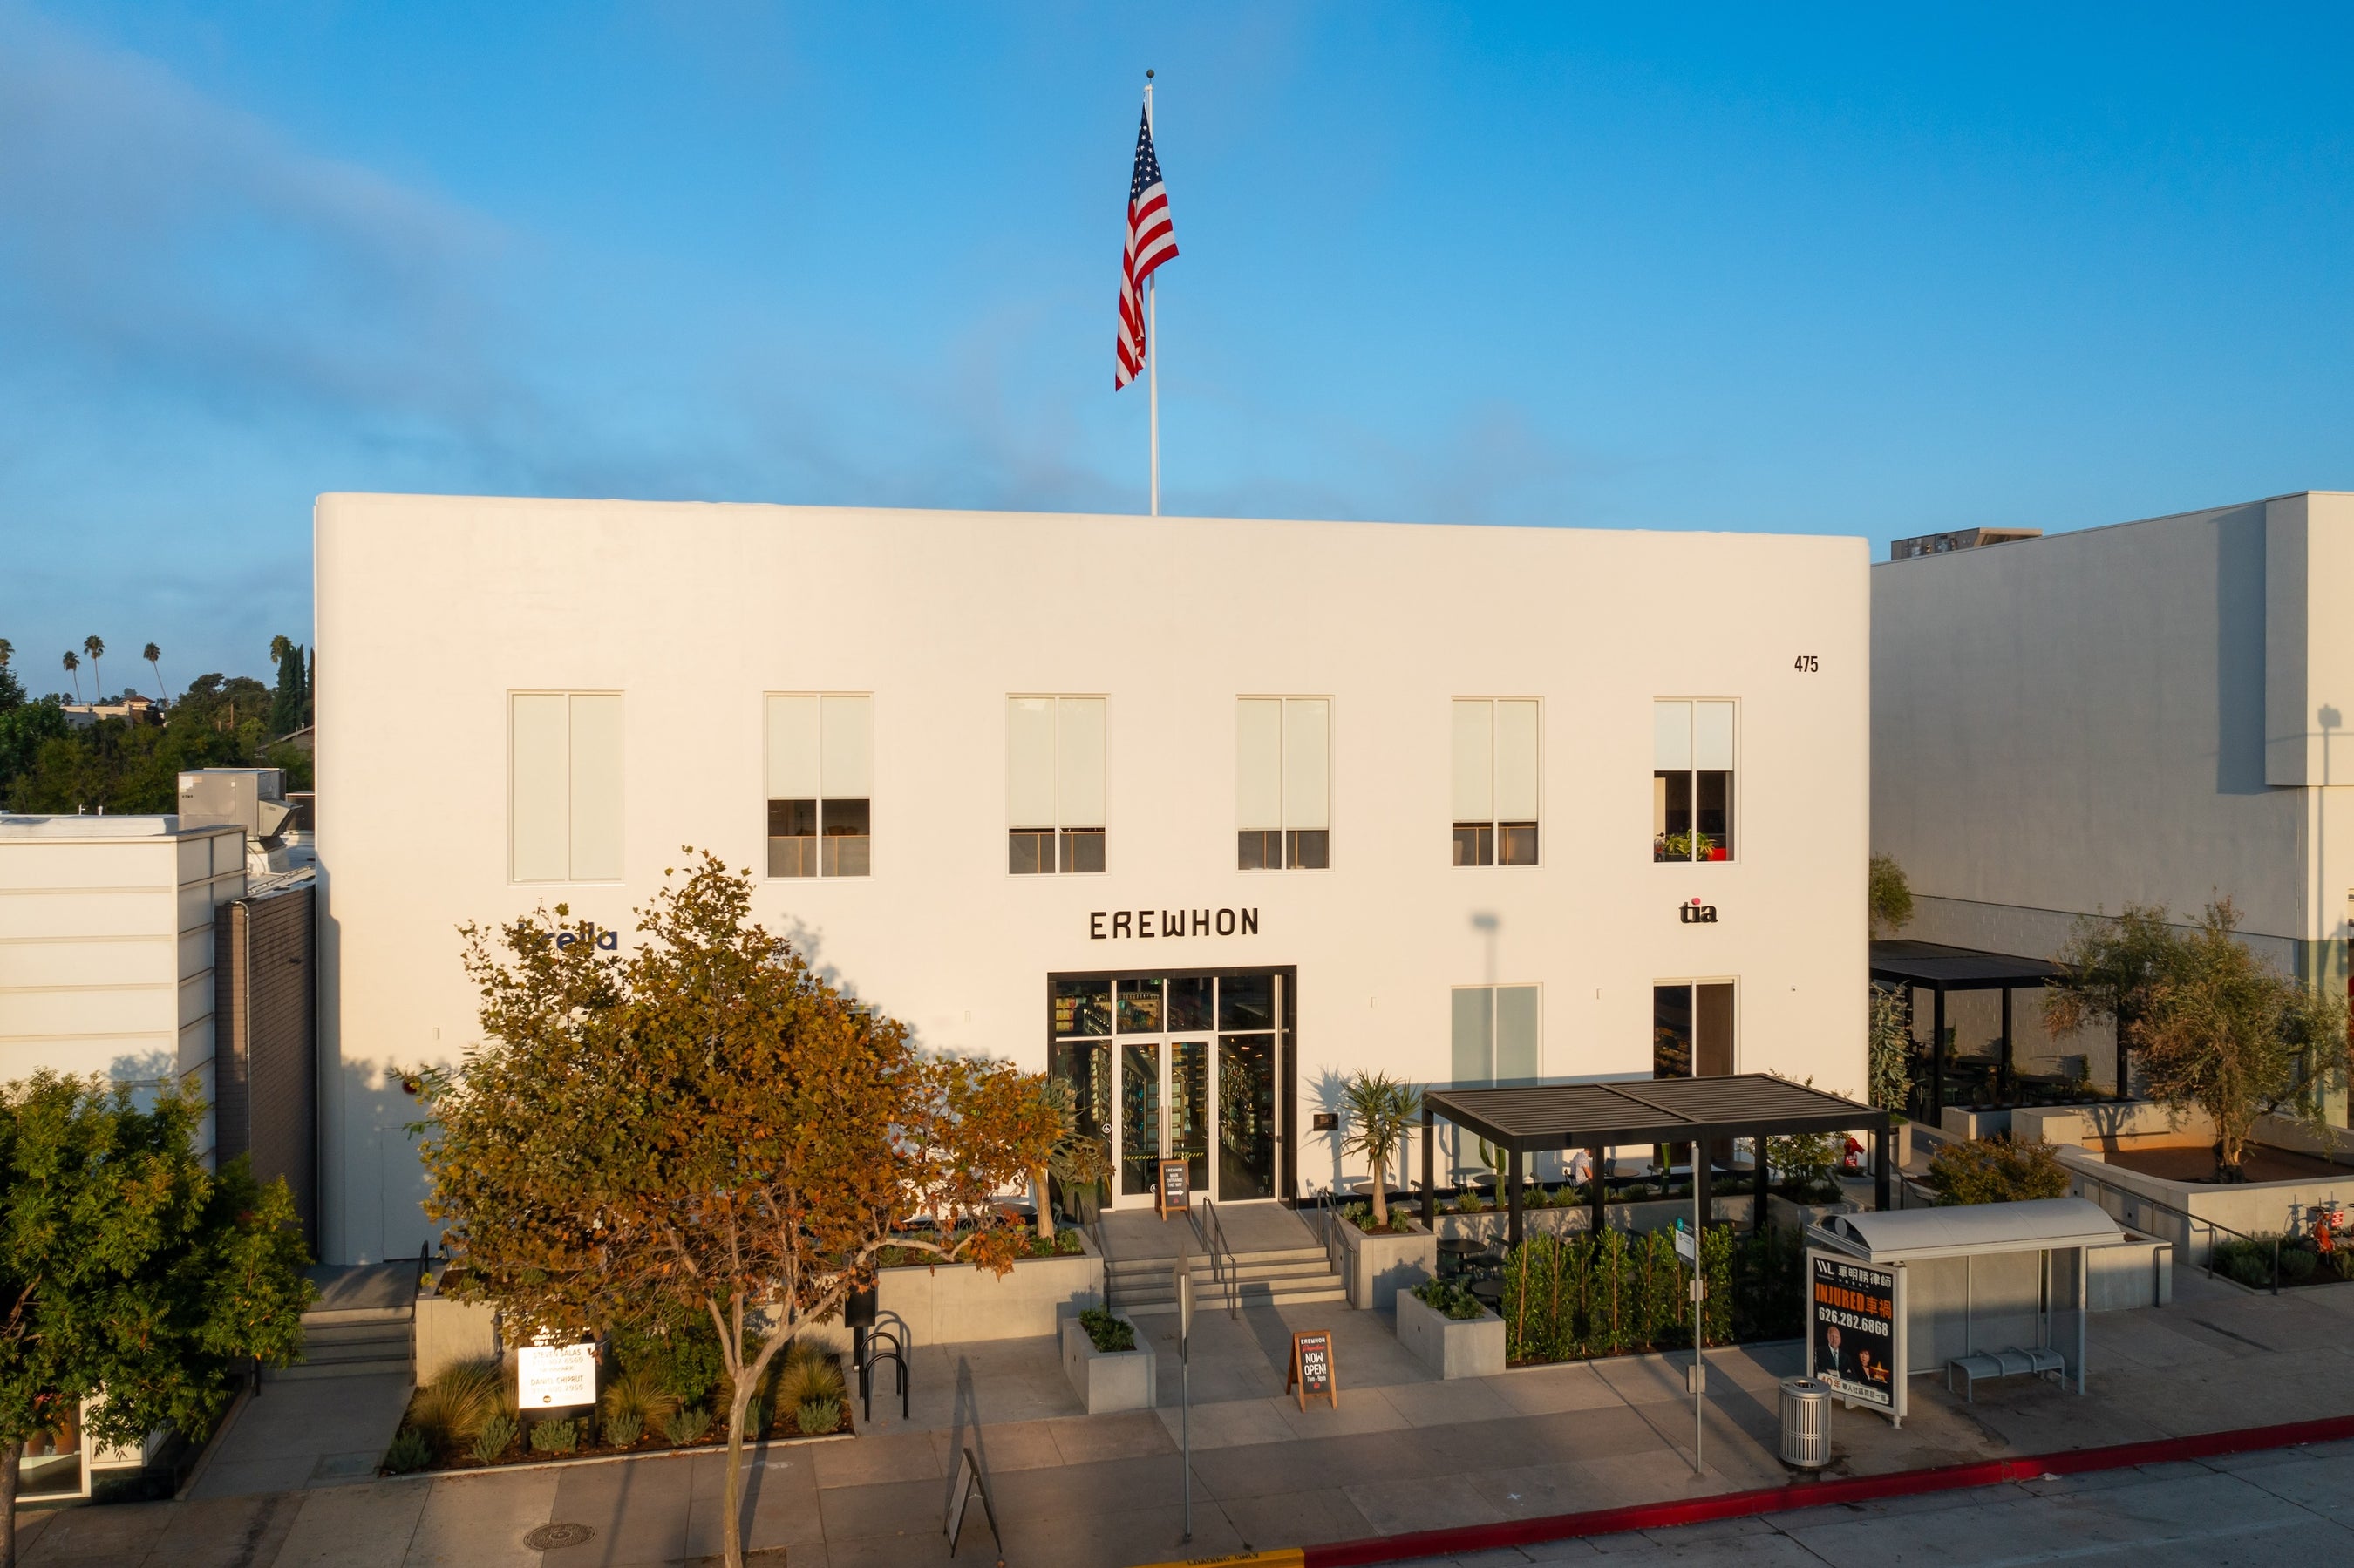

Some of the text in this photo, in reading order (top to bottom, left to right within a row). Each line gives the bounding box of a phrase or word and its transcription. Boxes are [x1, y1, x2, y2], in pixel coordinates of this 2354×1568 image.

[1794, 655, 1819, 673] 475
[1090, 907, 1258, 939] EREWHON
[1678, 897, 1718, 924] tia
[1815, 1282, 1865, 1312] INJURED
[1819, 1307, 1888, 1336] 626.282.6868
[1304, 1363, 1326, 1375] OPEN!
[1305, 1352, 1323, 1363] NOW
